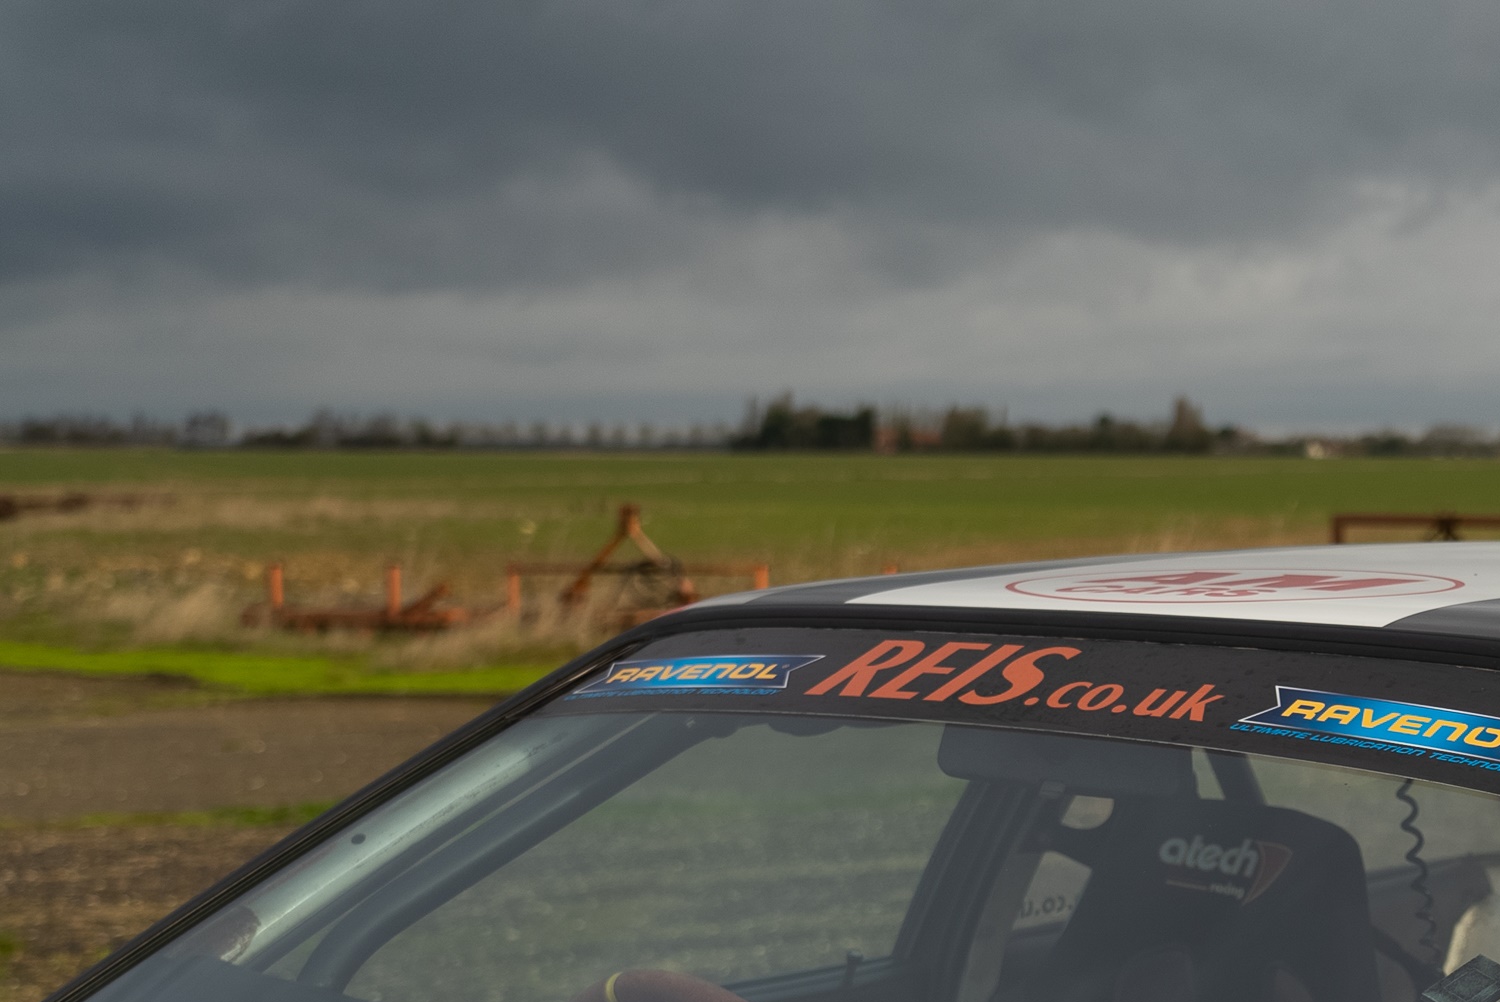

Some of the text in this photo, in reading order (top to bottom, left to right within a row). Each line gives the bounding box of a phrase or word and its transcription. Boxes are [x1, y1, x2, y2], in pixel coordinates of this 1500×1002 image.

[606, 662, 779, 684] RAVENOL
[803, 639, 1225, 722] REIS.co.uk
[1229, 722, 1313, 741] ULTIMATE
[1310, 734, 1426, 757] LUBRICATION
